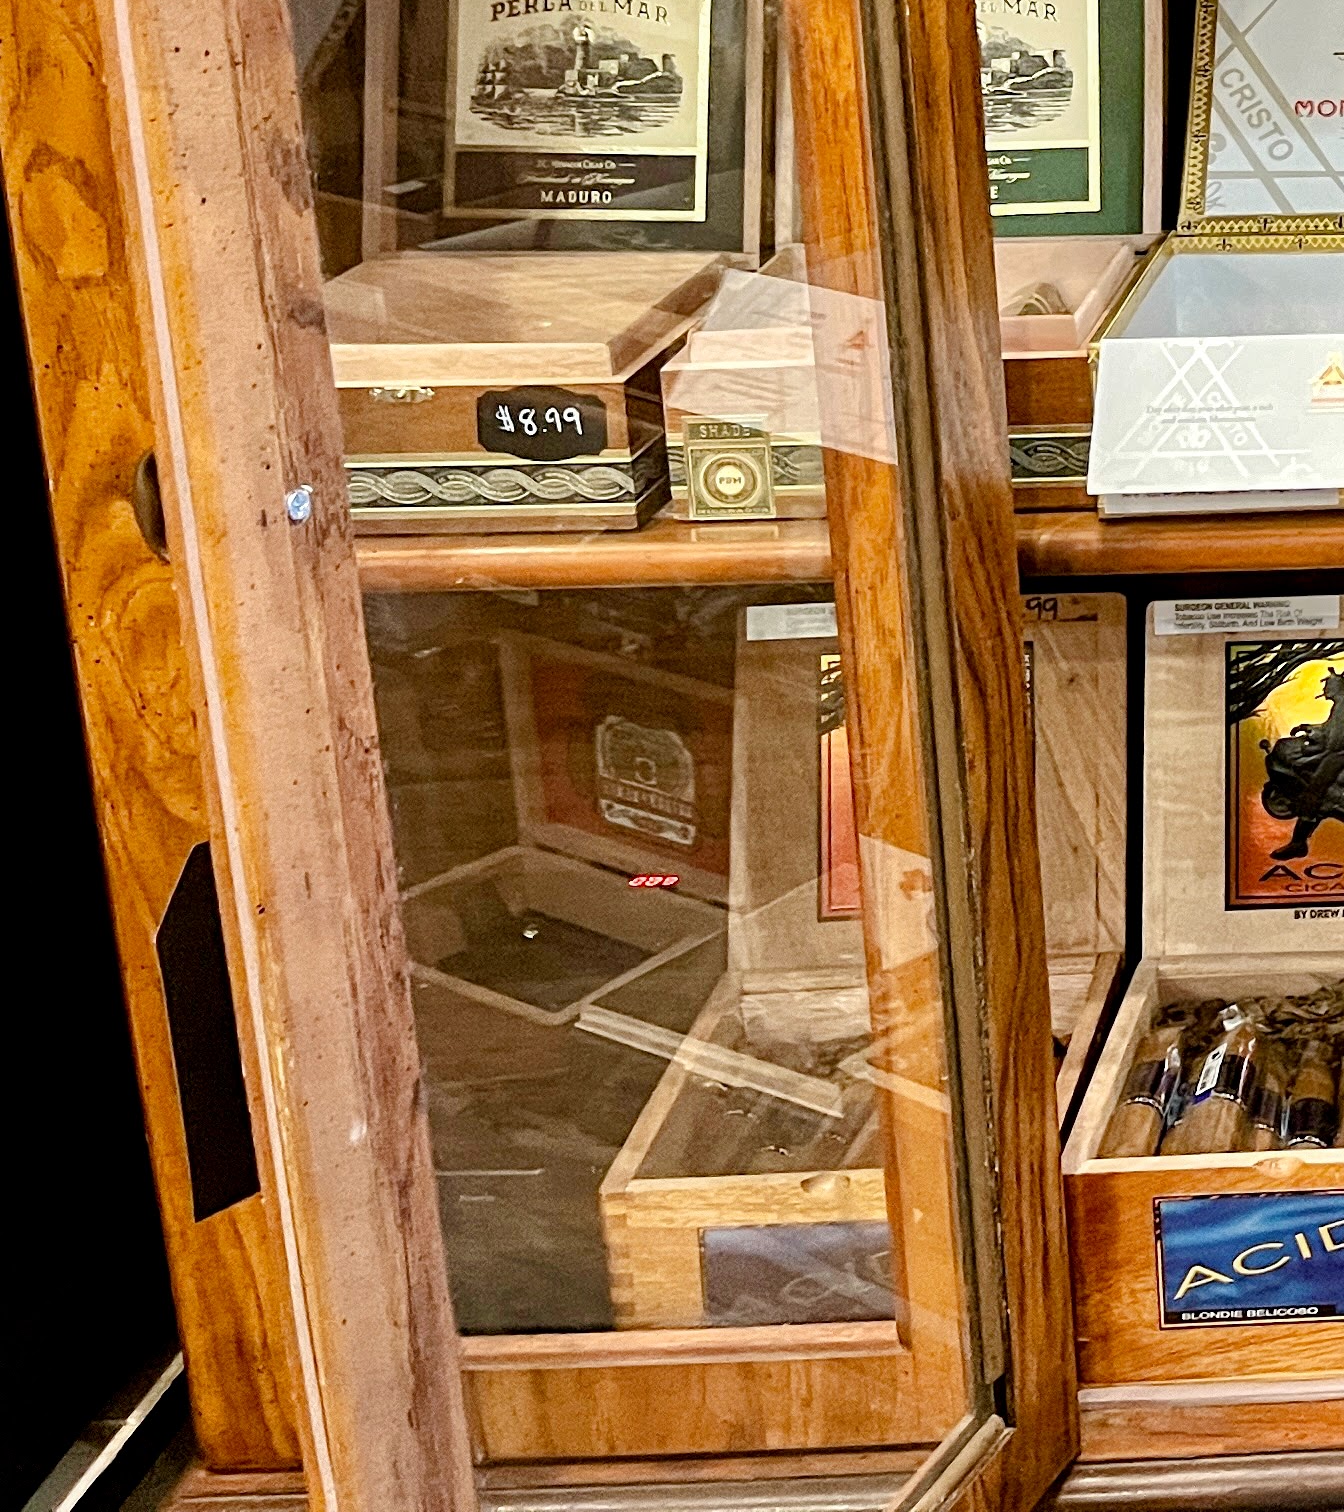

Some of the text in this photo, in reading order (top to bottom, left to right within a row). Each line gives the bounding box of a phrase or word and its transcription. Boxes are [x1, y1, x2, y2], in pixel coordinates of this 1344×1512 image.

[1219, 66, 1294, 162] CRISTO
[540, 190, 613, 206] MADURO
[495, 404, 584, 436] $8.99
[700, 423, 752, 439] SHADE
[1294, 909, 1308, 920] BY
[1310, 908, 1340, 919] DREW
[1181, 1305, 1319, 1321] BLONDIE BELICOSO
